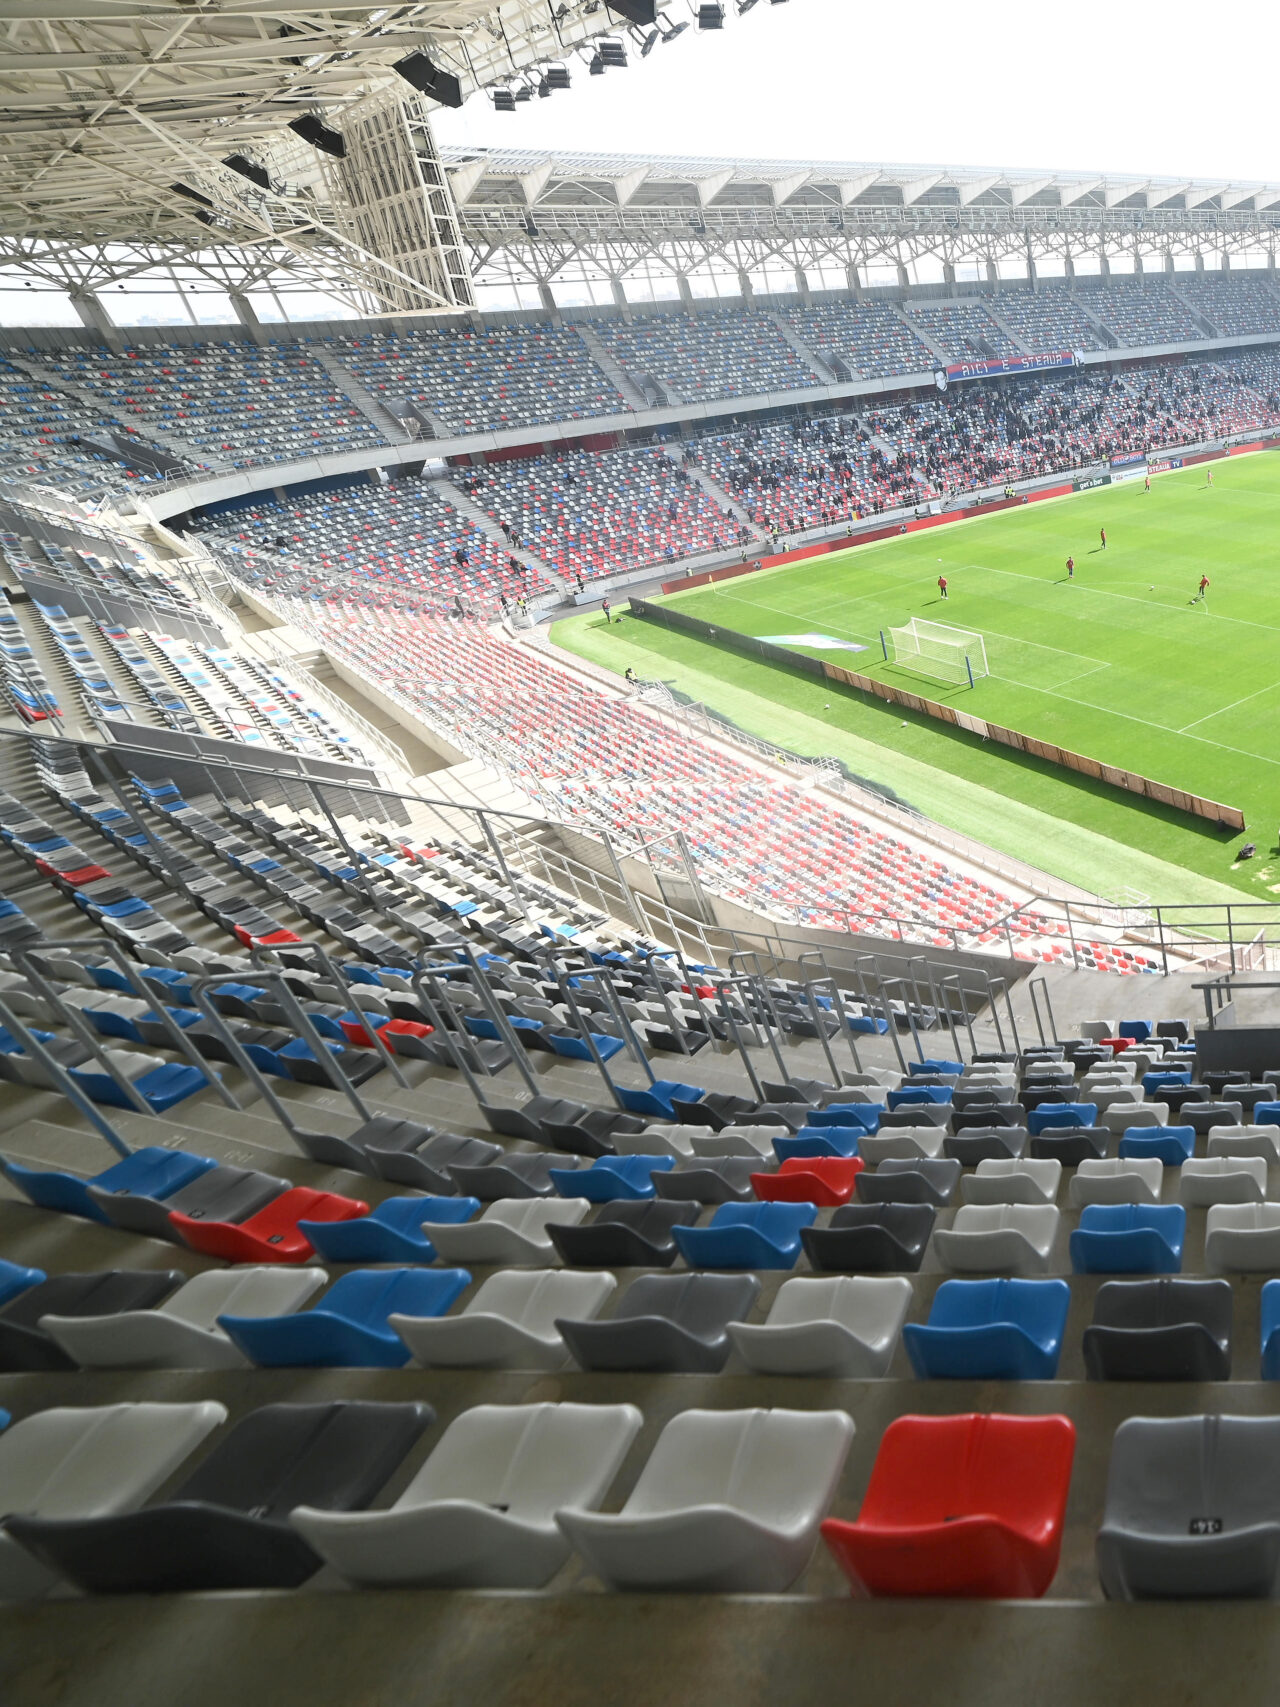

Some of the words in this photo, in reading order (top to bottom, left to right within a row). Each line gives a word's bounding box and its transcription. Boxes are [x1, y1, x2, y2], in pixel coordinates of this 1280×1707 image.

[961, 363, 988, 376] AICI
[1001, 359, 1010, 370] E
[1021, 354, 1062, 369] STEAUA
[1148, 463, 1171, 473] STEAUA
[1080, 480, 1093, 490] get's
[1094, 479, 1103, 487] bet
